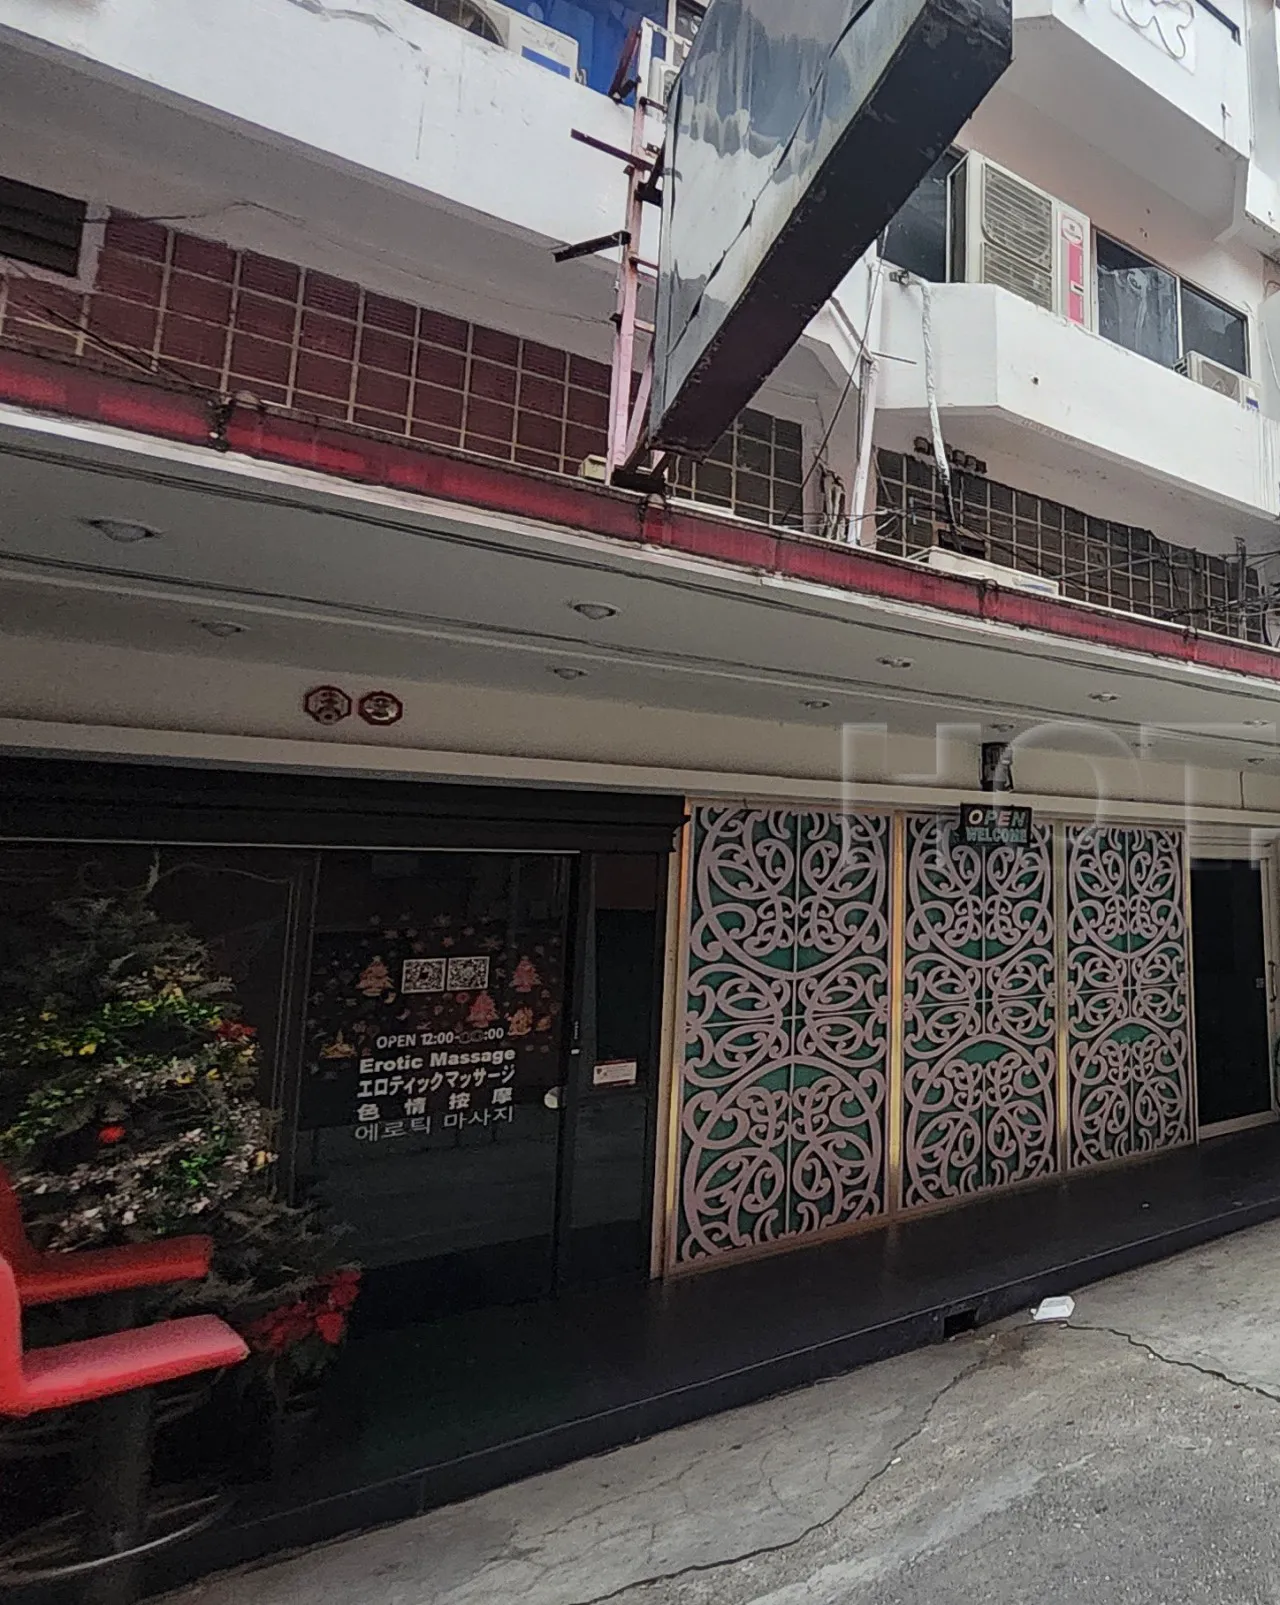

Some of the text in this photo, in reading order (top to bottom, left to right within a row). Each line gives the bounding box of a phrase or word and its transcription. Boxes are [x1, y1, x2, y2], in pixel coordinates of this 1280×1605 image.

[968, 809, 1026, 828] OPEN
[966, 826, 1027, 843] WELCOME
[376, 1027, 504, 1049] OPEN 12:00-:00
[359, 1049, 516, 1074] Erotic Massage
[357, 1064, 515, 1098] エロティックマッサージ
[355, 1106, 513, 1142] 에로틱 마사지
